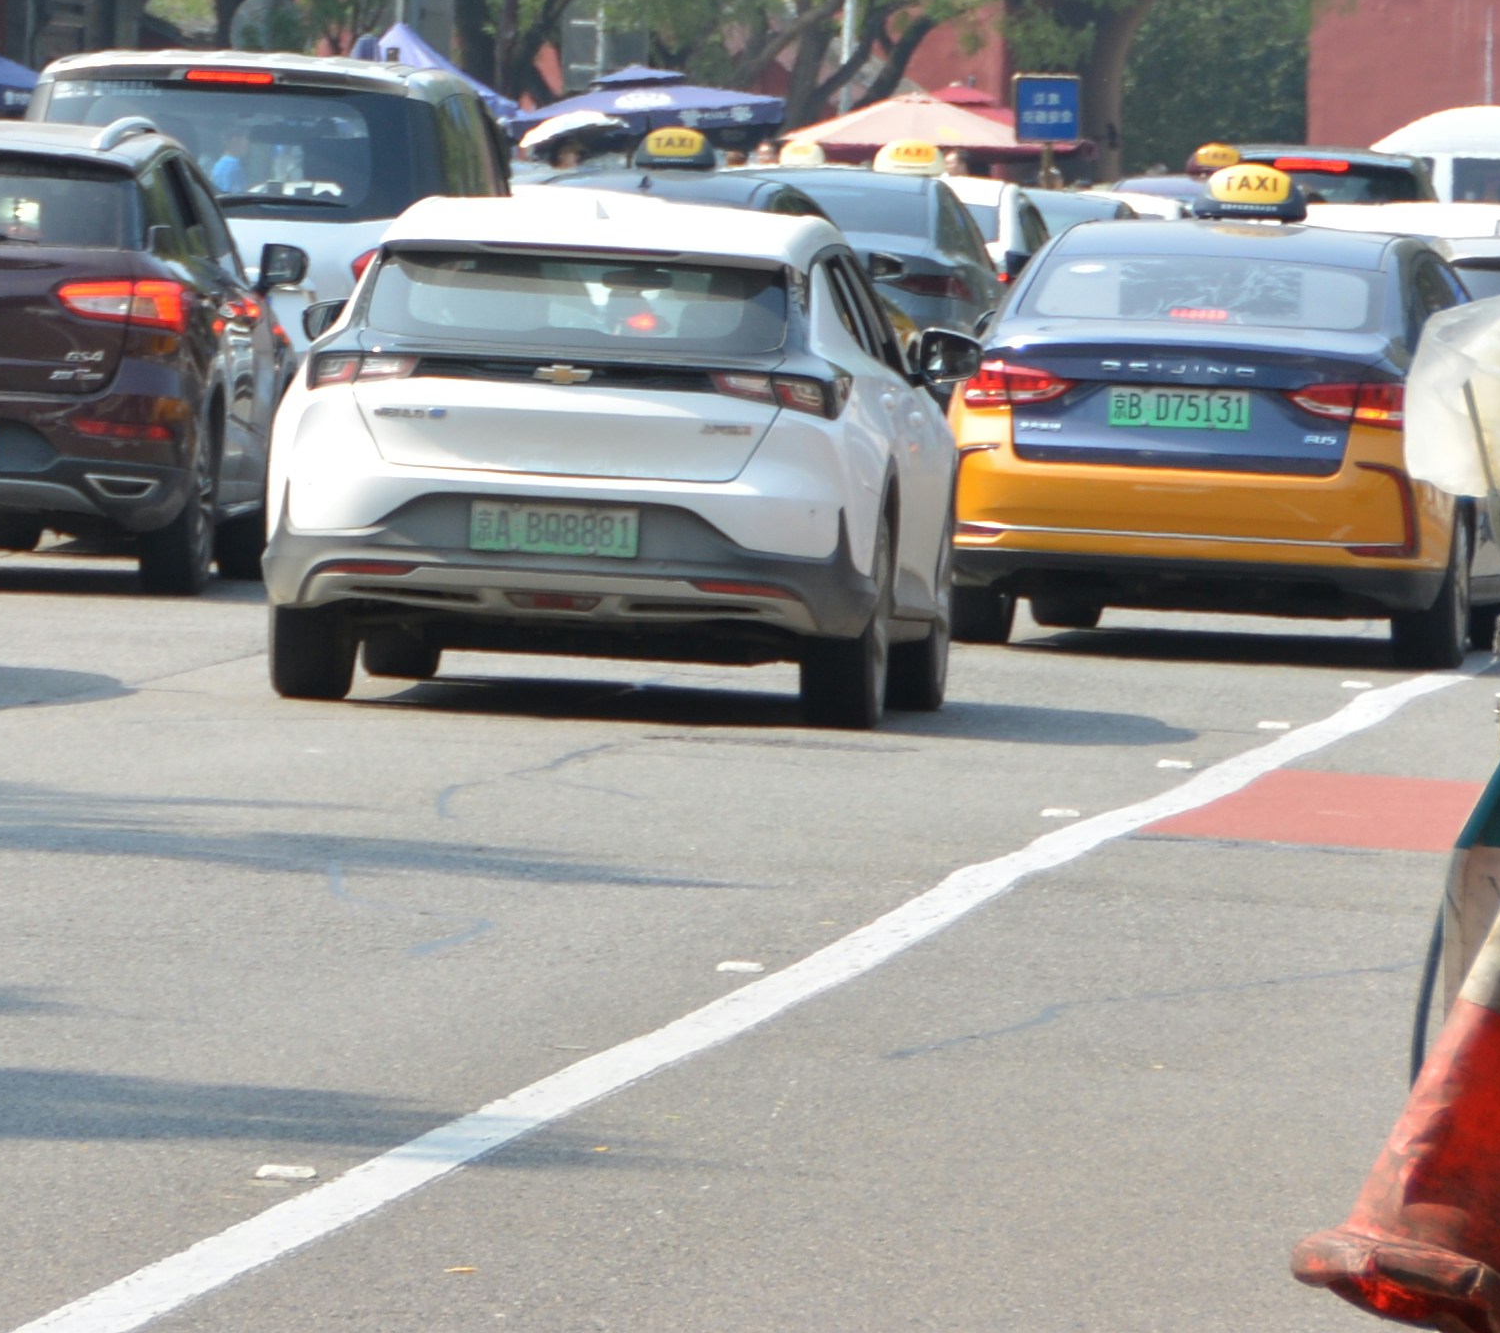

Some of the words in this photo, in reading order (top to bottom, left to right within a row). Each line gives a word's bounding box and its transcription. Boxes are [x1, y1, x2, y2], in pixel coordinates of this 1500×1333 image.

[654, 136, 695, 149] TAXI
[893, 147, 930, 158] TAXI
[1226, 175, 1279, 192] TAXI
[64, 351, 106, 363] GS4
[1101, 360, 1255, 377] BEIJING
